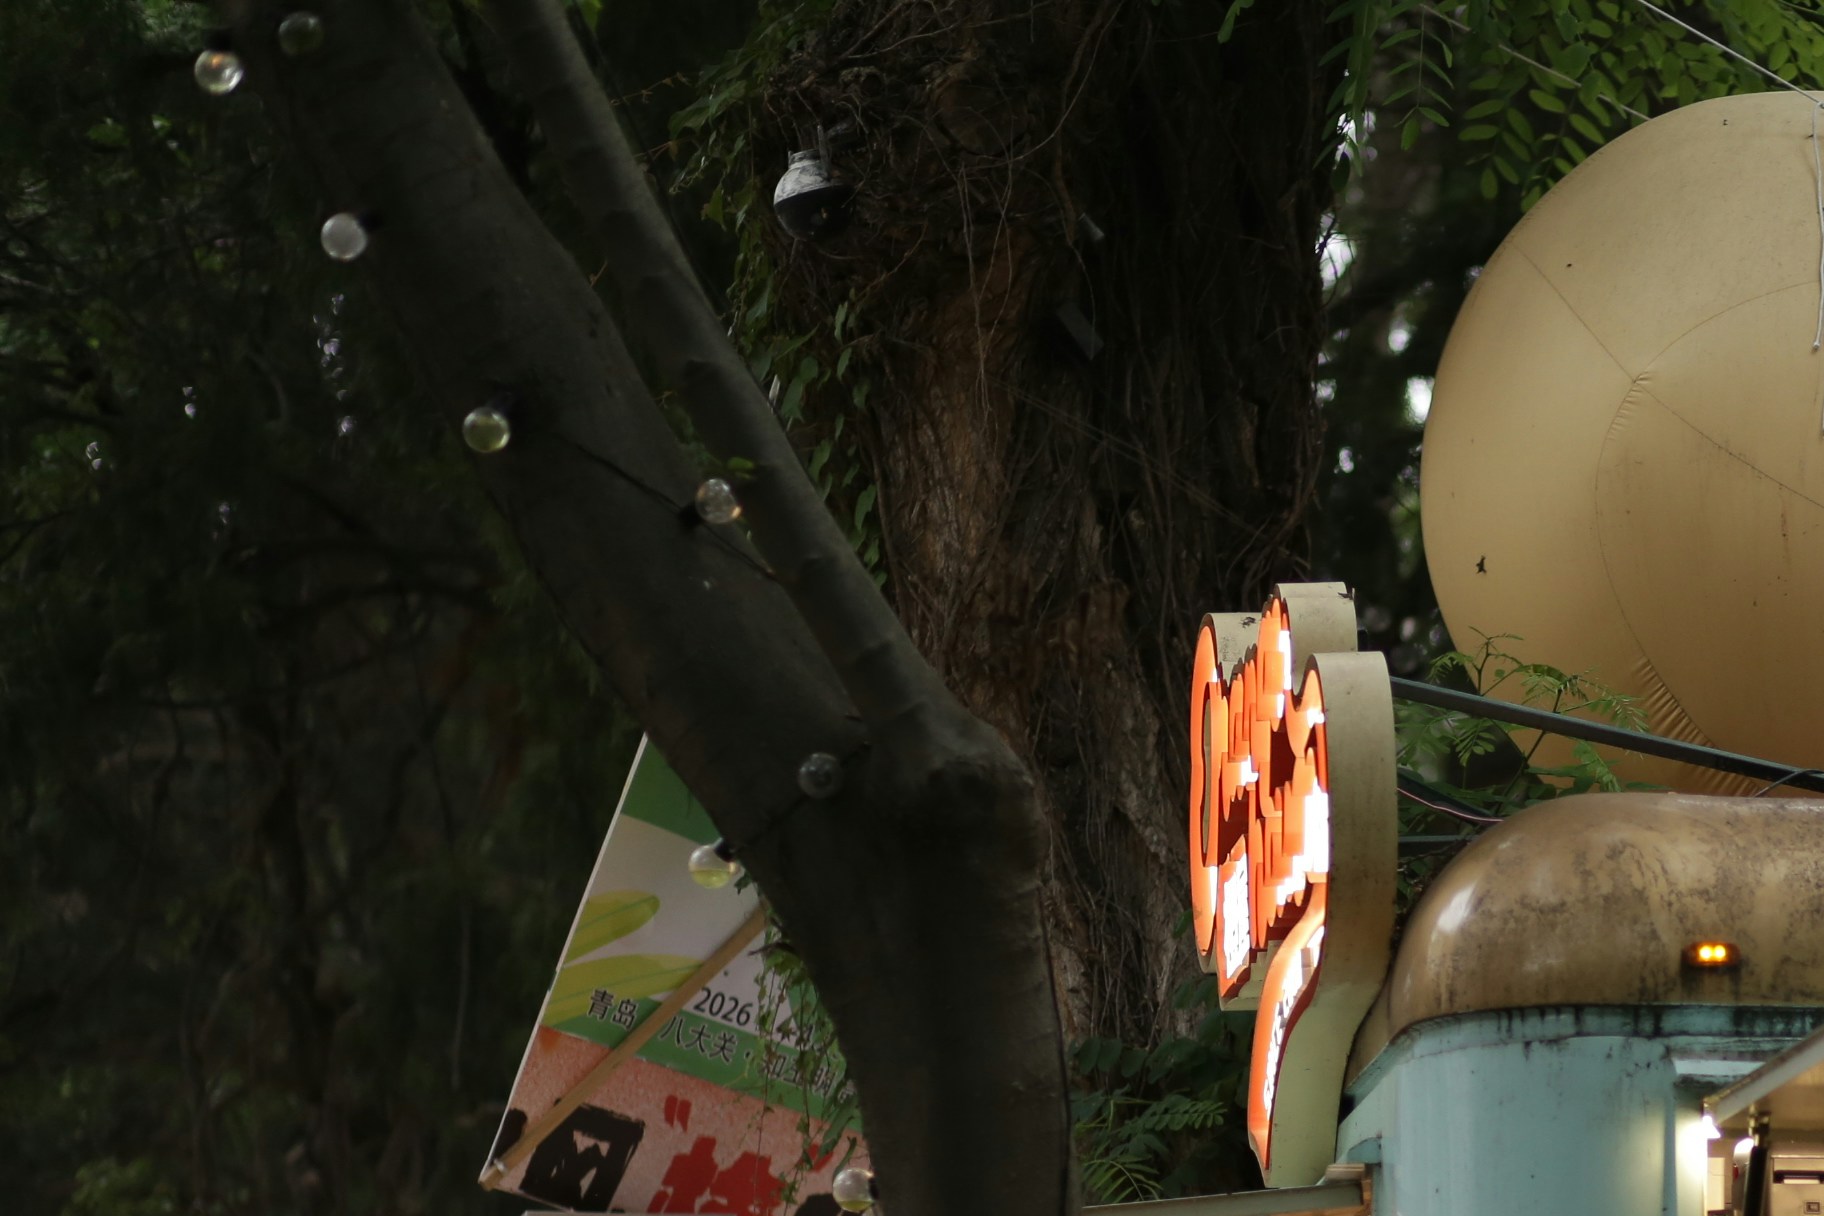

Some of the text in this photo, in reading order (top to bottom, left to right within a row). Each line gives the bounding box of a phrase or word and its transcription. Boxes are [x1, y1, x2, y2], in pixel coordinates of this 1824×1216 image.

[585, 988, 737, 1063] 青岛 八大关
[693, 986, 753, 1027] 2026
